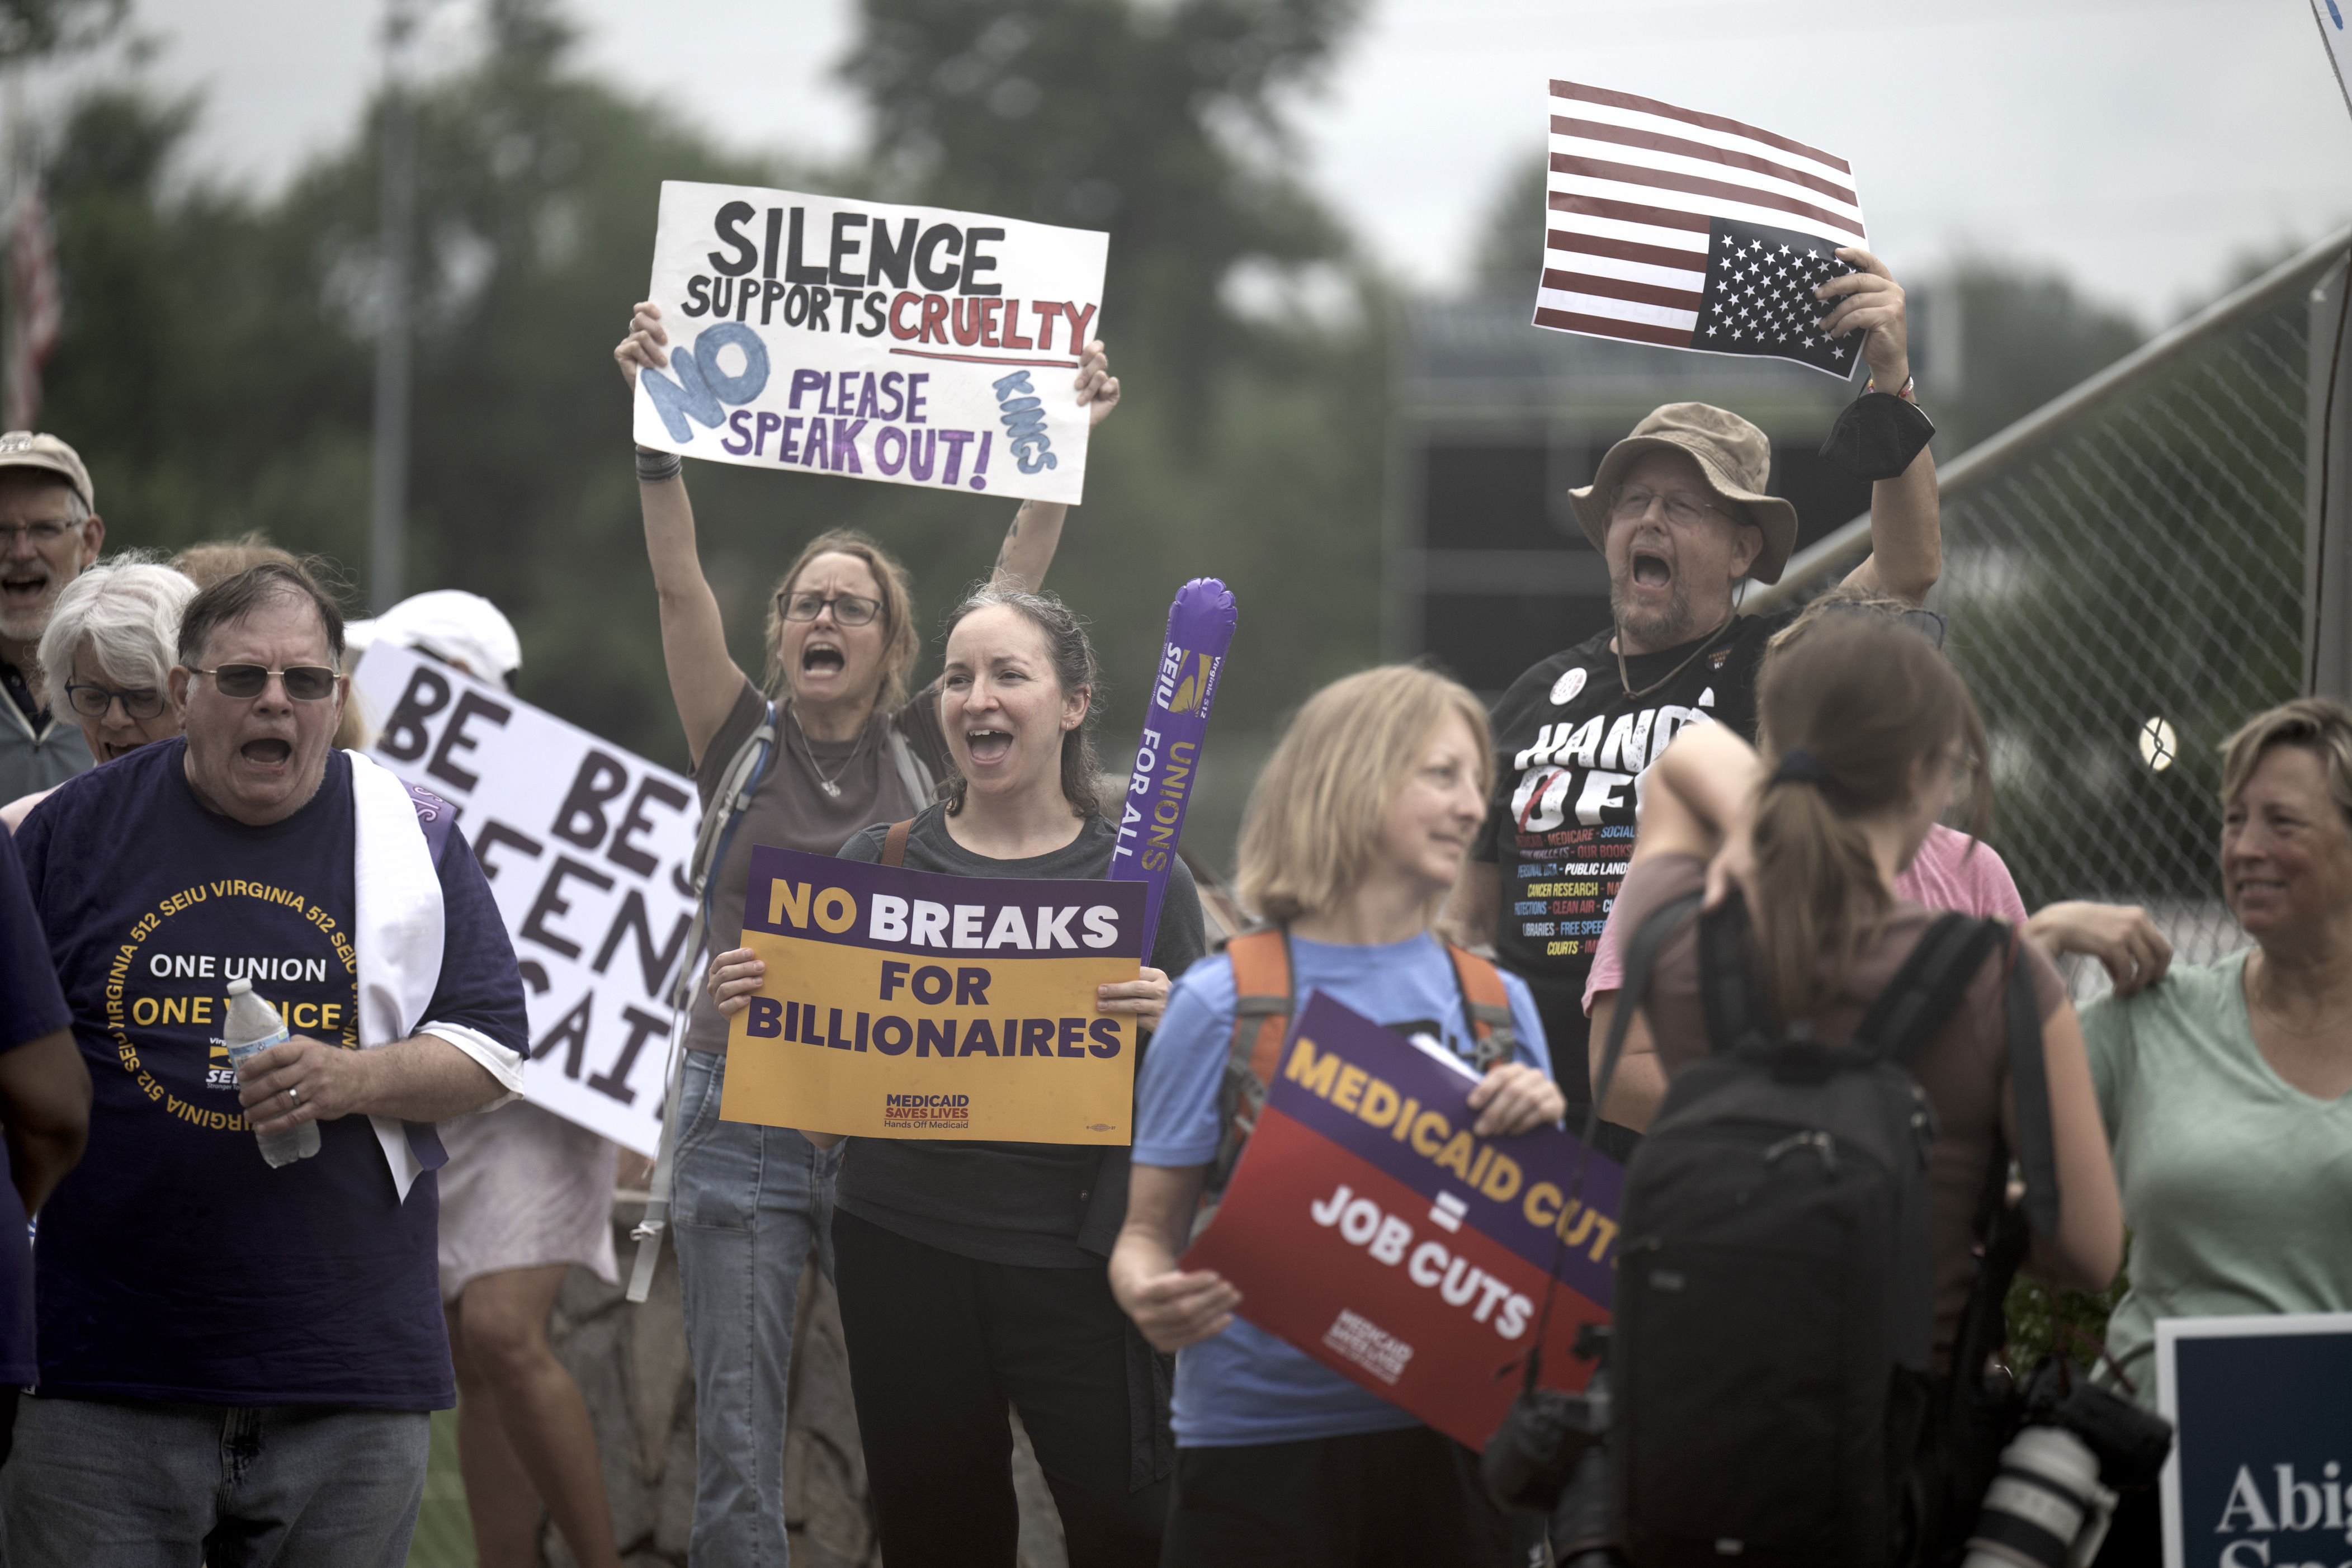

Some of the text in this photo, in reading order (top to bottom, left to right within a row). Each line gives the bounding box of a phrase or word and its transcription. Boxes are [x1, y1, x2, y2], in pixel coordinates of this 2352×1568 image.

[707, 201, 1005, 296] SILENCE
[681, 274, 1097, 355] SUPPORTS CRUELTY
[640, 321, 771, 444] NO
[788, 369, 929, 423] PLEASE
[721, 410, 993, 491] SPEAK OUT!
[992, 370, 1057, 474] KINGS
[1156, 643, 1181, 710] SEIU
[1201, 657, 1221, 719] Virginia 512
[378, 667, 512, 792] BE
[1514, 687, 1716, 773] HAND
[1112, 728, 1161, 862] FOR ALL
[1141, 741, 1196, 872] UNIONS
[1511, 764, 1644, 832] OF
[1547, 828, 1594, 846] MEDICARE
[1600, 825, 1635, 838] SOCIAL
[1577, 845, 1598, 858] OUR
[1600, 844, 1632, 858] BOOKS
[1527, 882, 1552, 898] CANCER
[1553, 882, 1598, 897] RESEARCH
[1565, 862, 1599, 876] PUBLIC
[159, 879, 357, 974] SEIU VIRGINIA 512 SEIU
[767, 877, 1120, 950] NO BREAKS
[1552, 900, 1578, 914] CLEAN
[1579, 900, 1595, 913] AIR
[1560, 921, 1580, 936] FREE
[150, 953, 326, 983] ONE UNION
[1547, 941, 1579, 956] COURTS
[133, 997, 213, 1026] ONE
[224, 998, 342, 1029] ICE
[880, 960, 991, 1006] FOR
[106, 913, 255, 1131] IRGINIA 512 SEIU VIRGINIA 512
[210, 1037, 227, 1046] Virg
[746, 995, 1121, 1059] BILLIONAIRES
[205, 1069, 238, 1084] SEI
[886, 1094, 969, 1107] MEDICAID
[885, 1107, 969, 1118] SAVES LIVES
[1284, 1037, 1619, 1271] MEDICAID CUT
[1311, 1184, 1534, 1339] JOB CUTS
[2213, 1461, 2352, 1545] Abi
